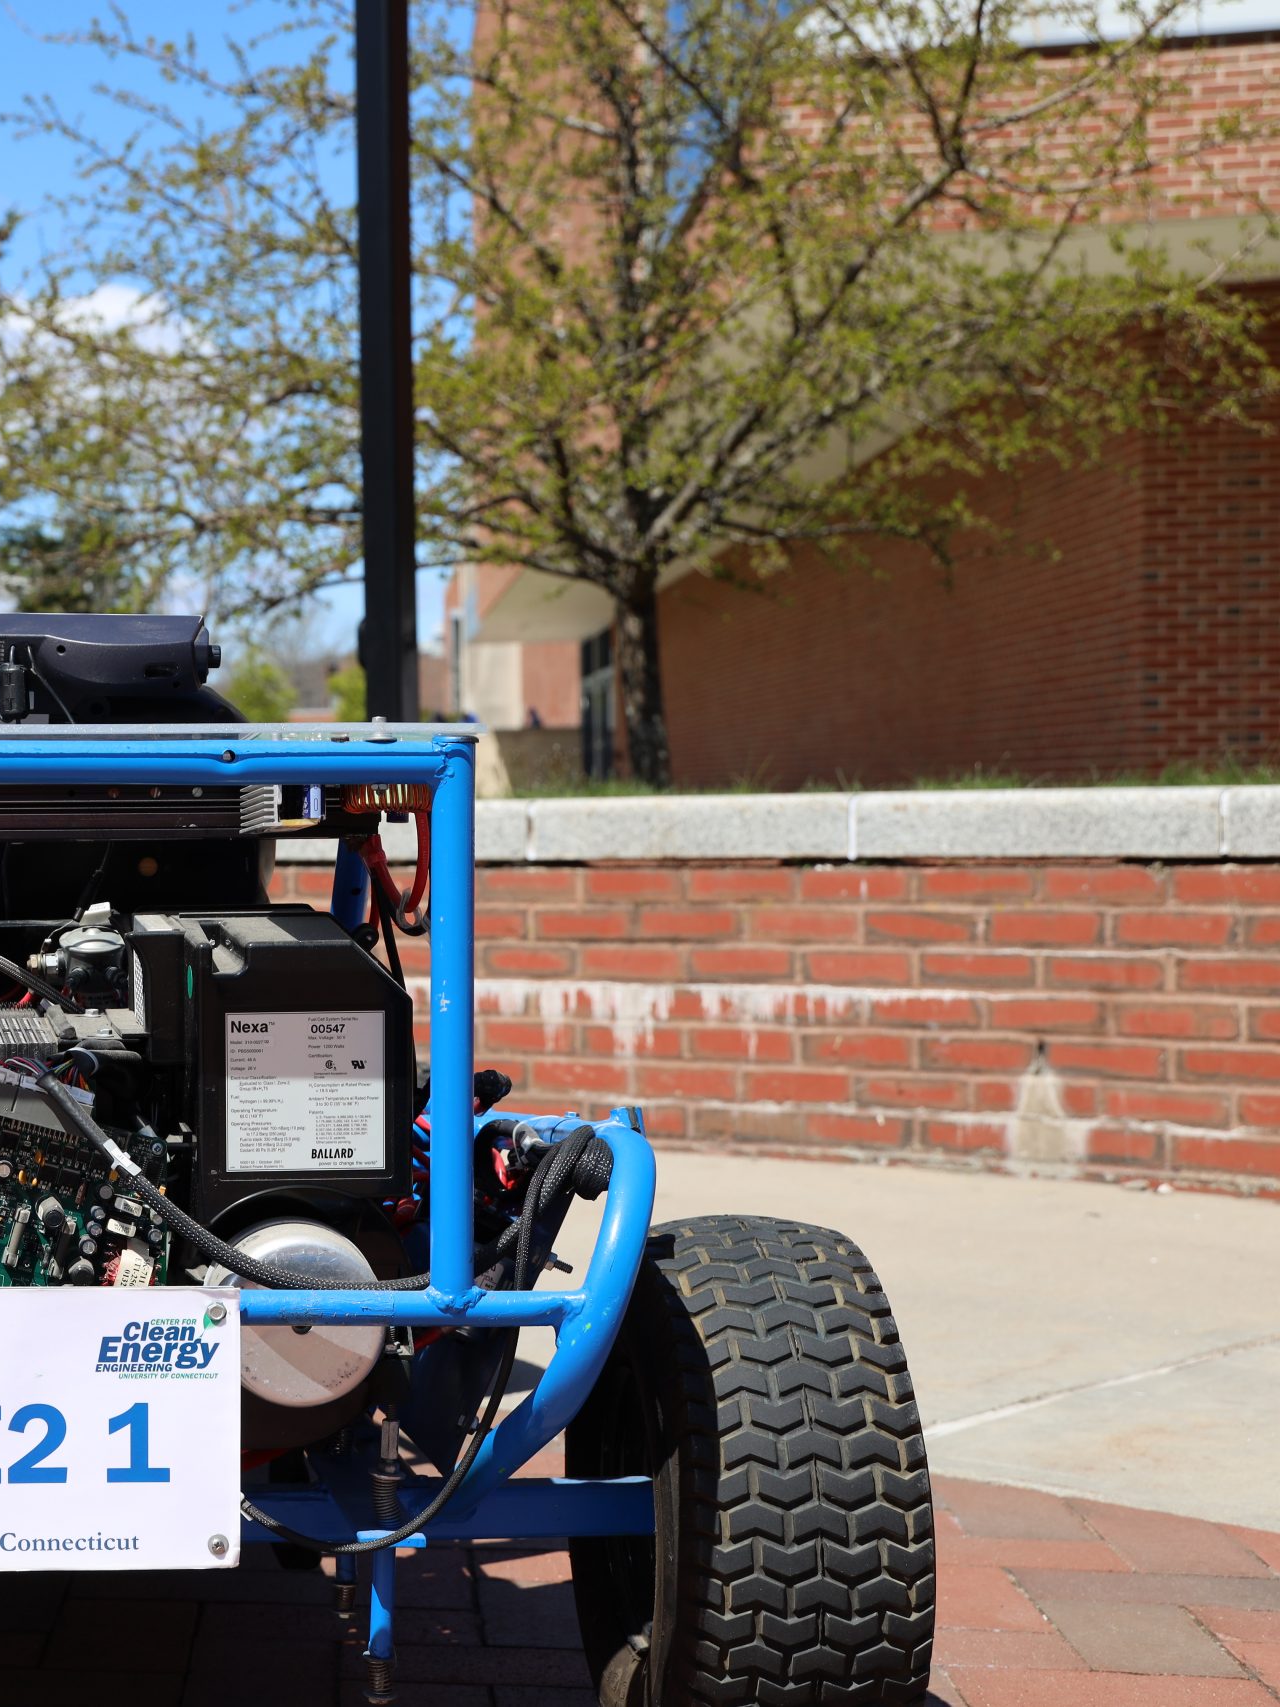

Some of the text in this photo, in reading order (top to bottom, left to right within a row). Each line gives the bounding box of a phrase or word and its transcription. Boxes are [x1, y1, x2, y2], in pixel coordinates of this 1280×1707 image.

[310, 1023, 346, 1034] 00547
[123, 1321, 195, 1342] Clean
[98, 1336, 220, 1370] Energy
[95, 1363, 173, 1372] ENGINEERING
[106, 1402, 171, 1484] 1
[0, 1532, 139, 1552] Connecticut
